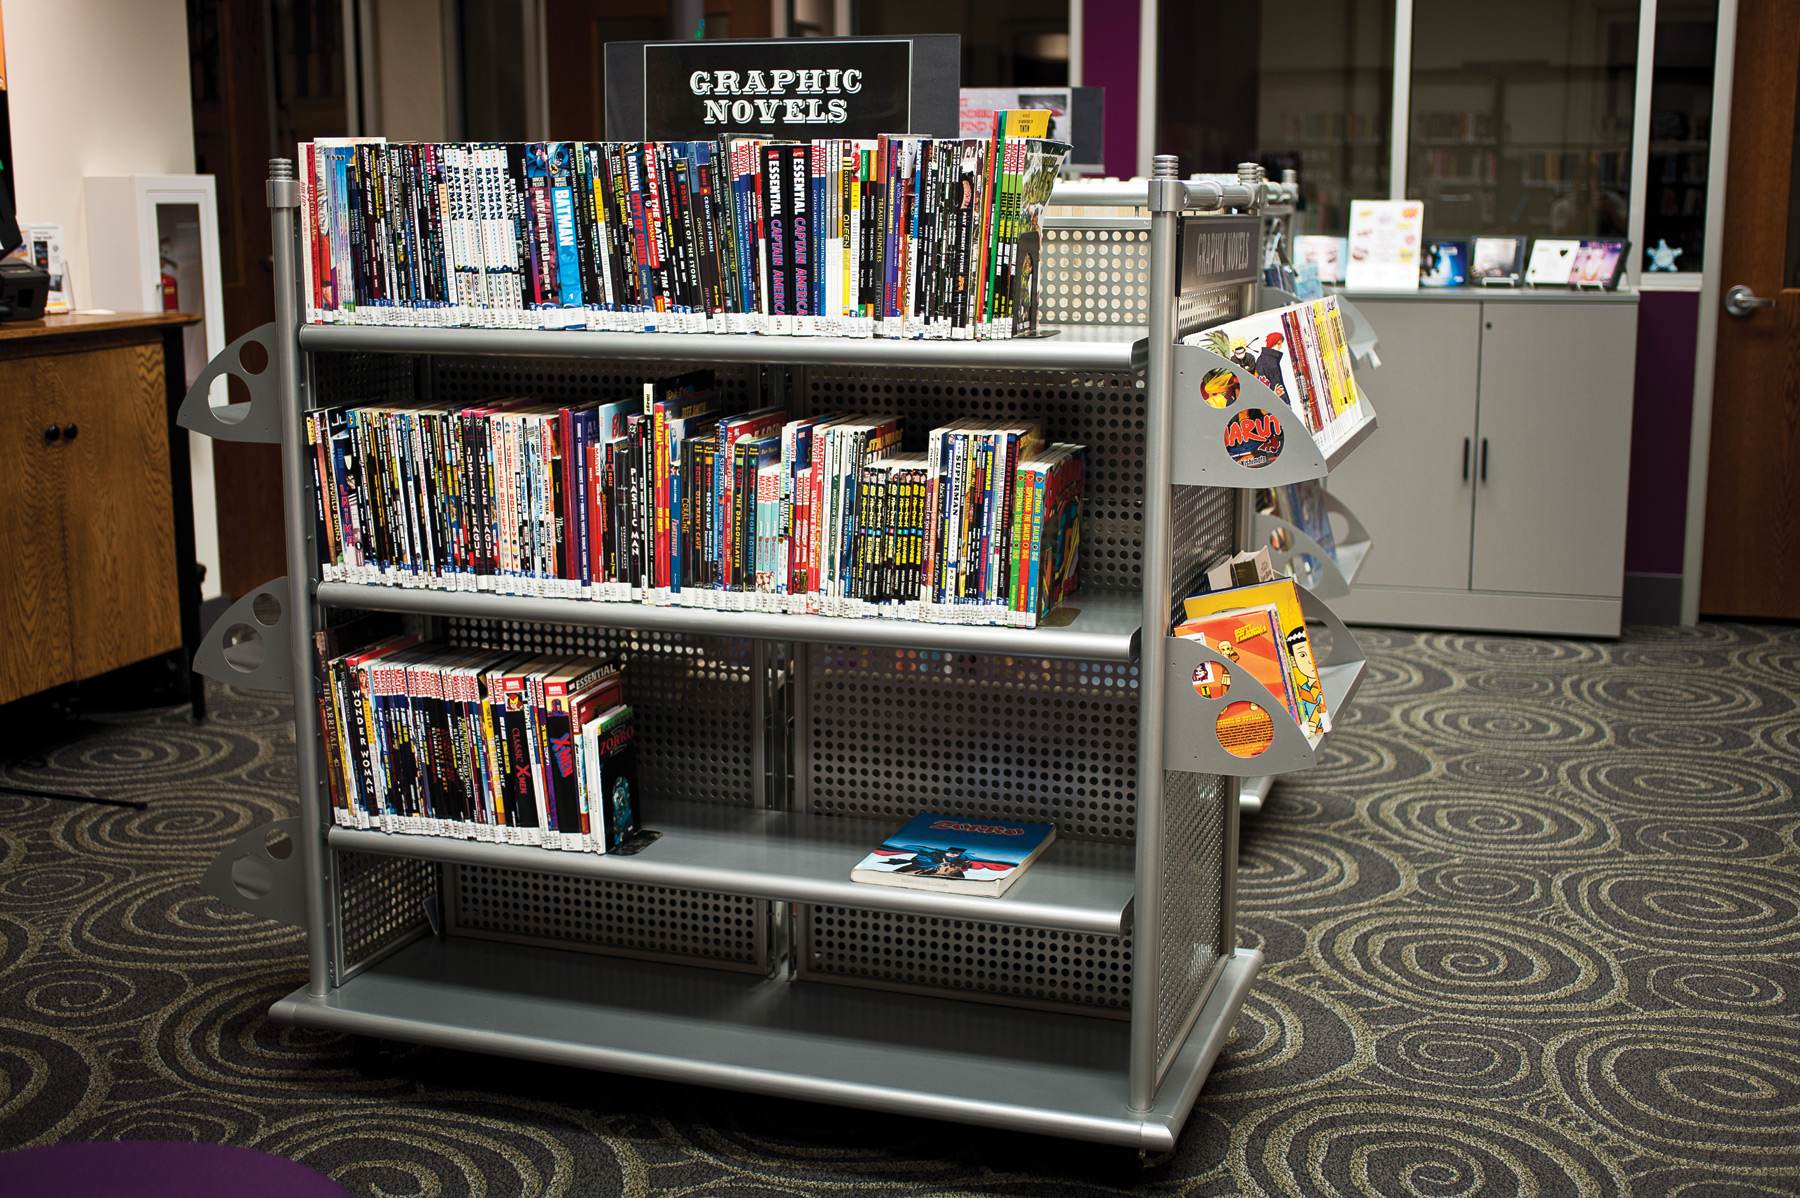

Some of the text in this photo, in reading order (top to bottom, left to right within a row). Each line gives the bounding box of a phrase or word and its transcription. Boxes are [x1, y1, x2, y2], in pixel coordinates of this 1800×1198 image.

[690, 68, 863, 95] GRAPHIC
[703, 98, 848, 125] NOVELS
[645, 149, 654, 180] TALES
[651, 182, 657, 195] OF
[446, 166, 457, 221] BATMAN
[453, 167, 464, 219] BATMAN
[463, 168, 474, 220] BATMAN
[476, 167, 487, 220] BATMAN
[485, 167, 496, 220] BATMAN
[492, 167, 503, 219] BATMAN
[502, 167, 513, 220] BATMAN
[509, 179, 521, 238] BATMAN HUSH
[628, 156, 646, 265] BATMAN CITY OF CRIME
[652, 200, 660, 218] THE
[962, 180, 970, 208] GODZILLA
[535, 190, 550, 260] BRAVE AND THE BOLD
[555, 190, 574, 246] BATMAN
[647, 213, 655, 240] BATMAN
[654, 221, 665, 262] BATMAN
[686, 230, 692, 240] OF
[707, 220, 711, 228] OF
[770, 161, 785, 315] ESSENTIAL CAPTAIN AMERICA
[793, 158, 807, 316] ESSENTIAL CAPTAIN AMERICA
[1197, 231, 1250, 276] GRAPHIC NOVELS
[655, 412, 663, 444] SHAZAM!
[497, 444, 505, 488] JUSTICE
[953, 455, 962, 516] SUPERMAN
[329, 483, 341, 541] WORLD BURNS
[341, 485, 355, 546] LAIKA
[467, 448, 481, 557] JUSTICE LEAGUE
[479, 448, 492, 557] JUSTICE LEAGUE
[631, 468, 639, 555] PLASTIC MAN
[682, 498, 690, 533] CORALINE
[323, 682, 331, 698] THE
[536, 681, 544, 707] MARVEL
[576, 664, 617, 690] ESSENTIAL
[326, 704, 337, 749] ARRIVAL
[353, 690, 374, 794] WONDER WOMAN
[600, 725, 635, 756] ZORRO
[491, 750, 500, 776] ETERNAL
[512, 728, 530, 794] CLASSIC X-MEN
[929, 820, 1025, 837] ZORRO
